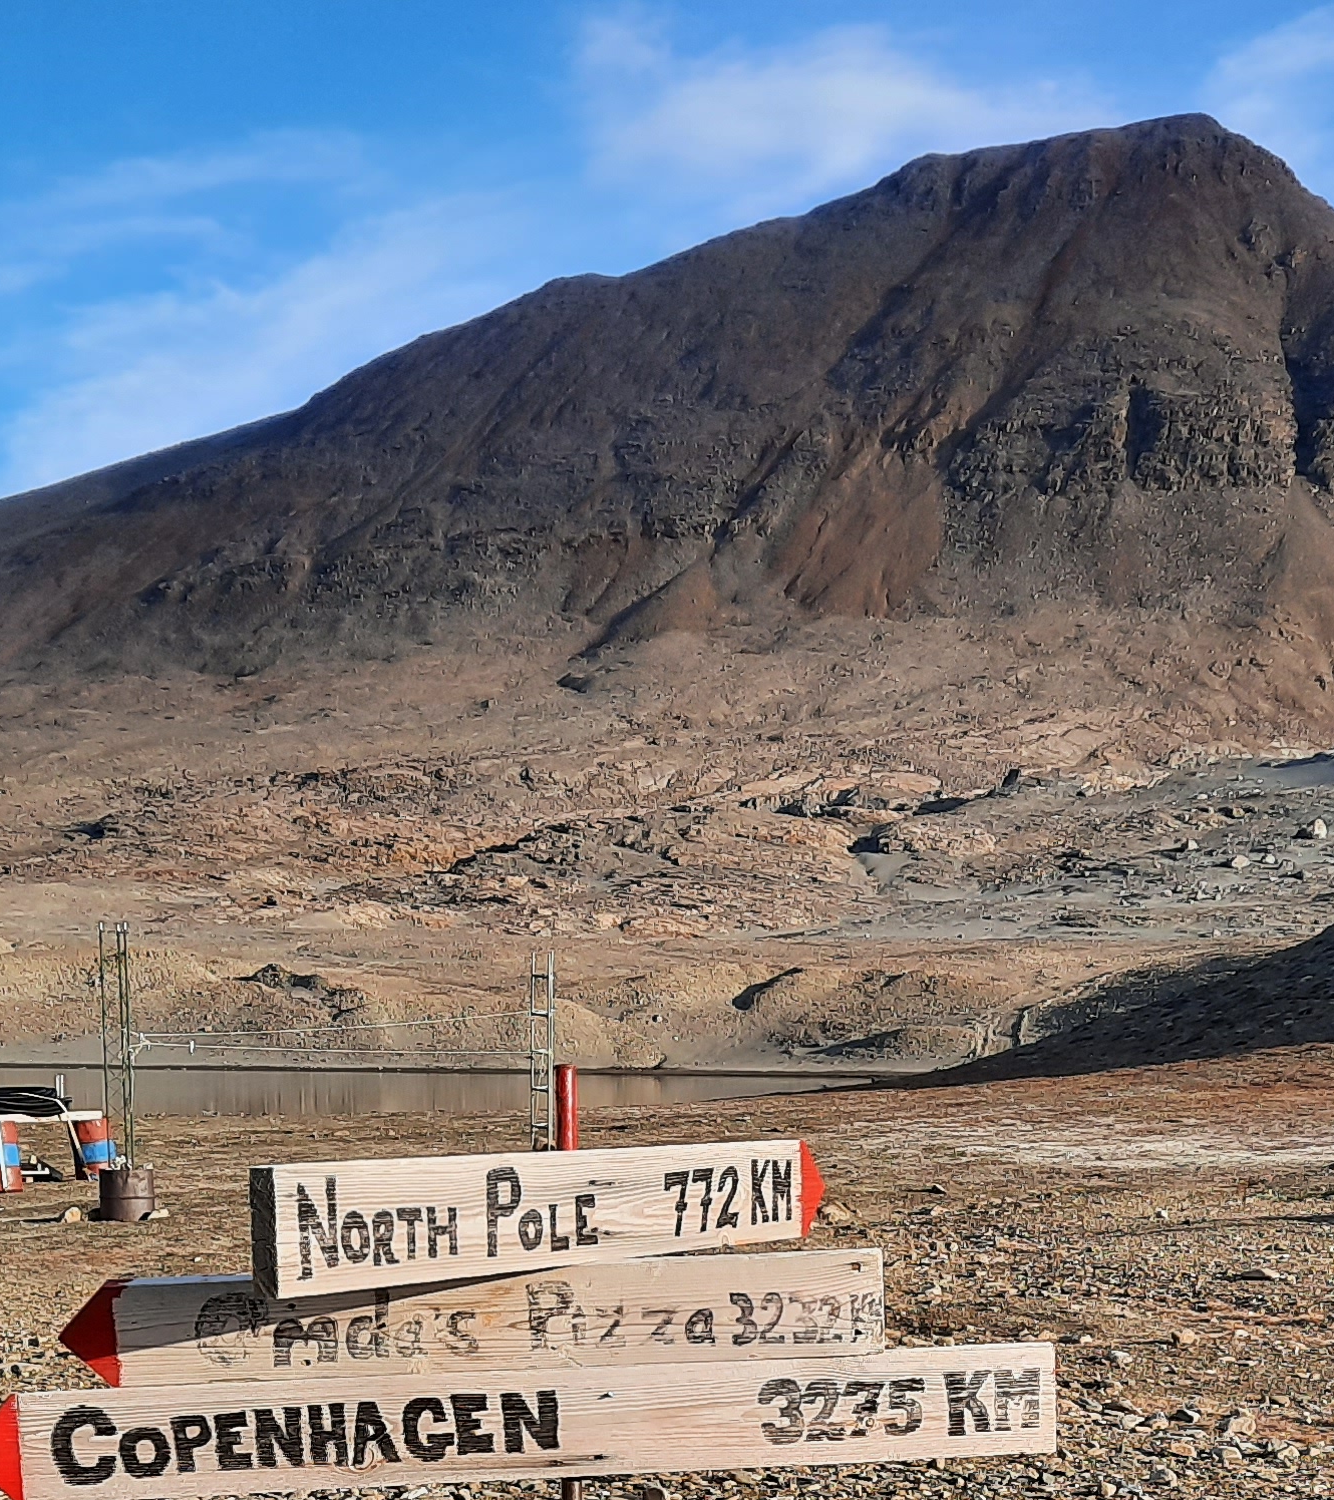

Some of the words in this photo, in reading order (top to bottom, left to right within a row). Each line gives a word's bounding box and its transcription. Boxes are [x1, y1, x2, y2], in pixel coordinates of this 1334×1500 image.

[297, 1176, 459, 1281] NORTH
[486, 1166, 599, 1257] POLE
[664, 1165, 740, 1236] 772
[751, 1158, 793, 1225] KM
[51, 1391, 560, 1486] COPENHAGEN
[757, 1378, 925, 1445] 3275
[942, 1368, 1040, 1436] KM
